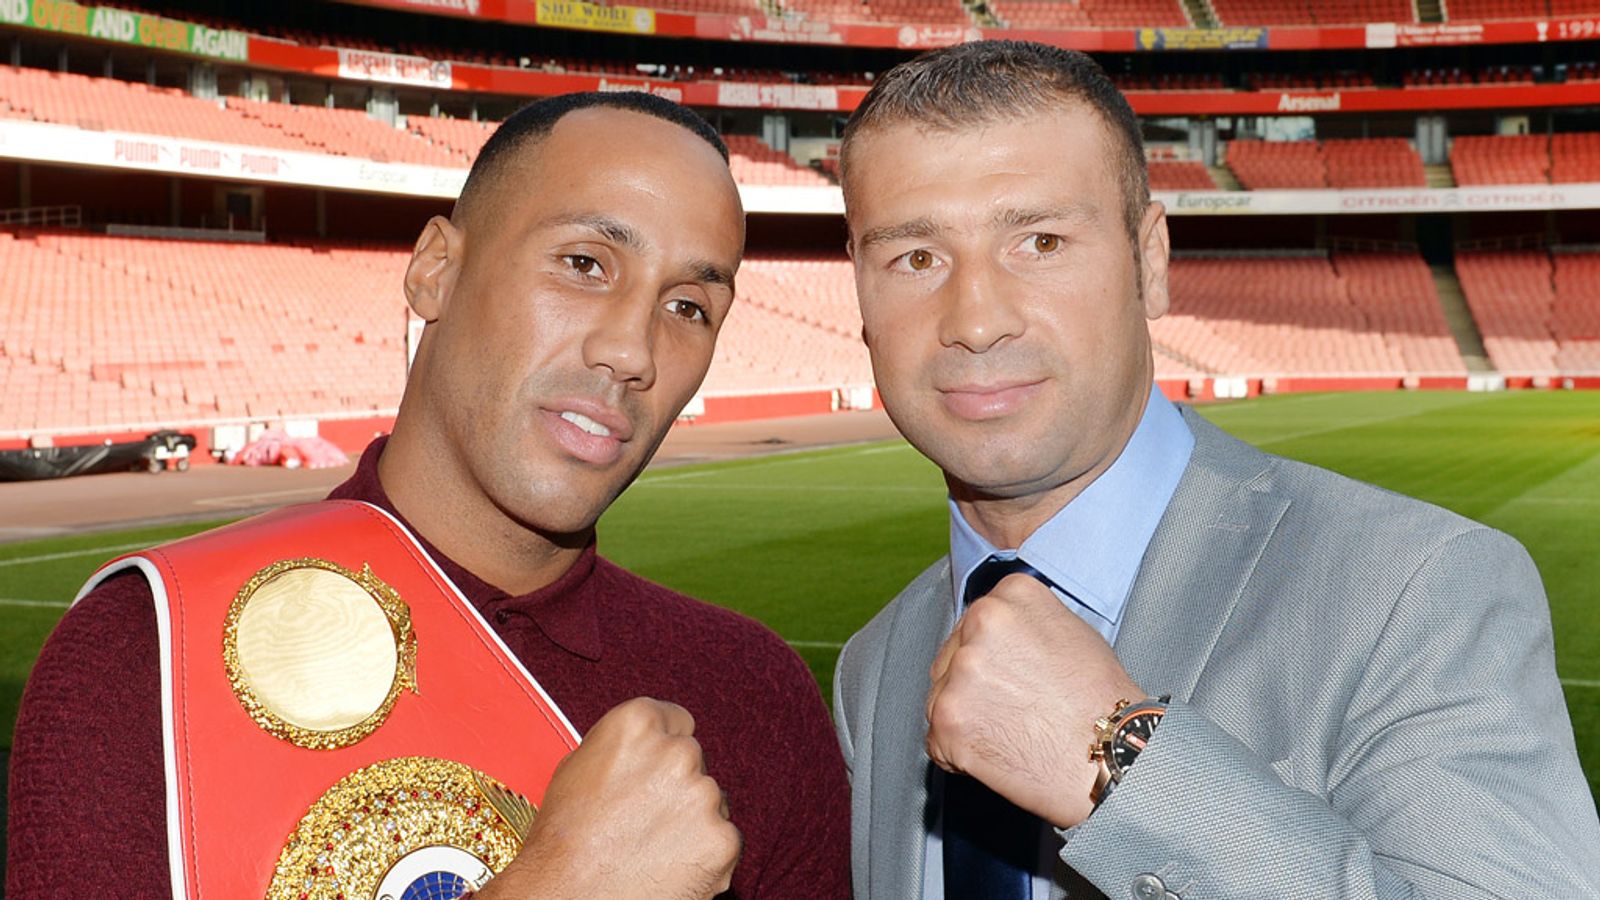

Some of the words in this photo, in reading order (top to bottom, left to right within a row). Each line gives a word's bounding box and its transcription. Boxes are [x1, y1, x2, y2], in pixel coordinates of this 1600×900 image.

[32, 0, 88, 35] OVER
[91, 6, 135, 42] AND
[138, 15, 188, 51] OVER
[192, 24, 247, 60] AGAIN
[1278, 92, 1340, 111] Arsenal
[114, 139, 159, 163] PUMA
[180, 146, 221, 169] PUMA
[240, 153, 279, 176] PUMA
[1176, 193, 1253, 210] Europcar
